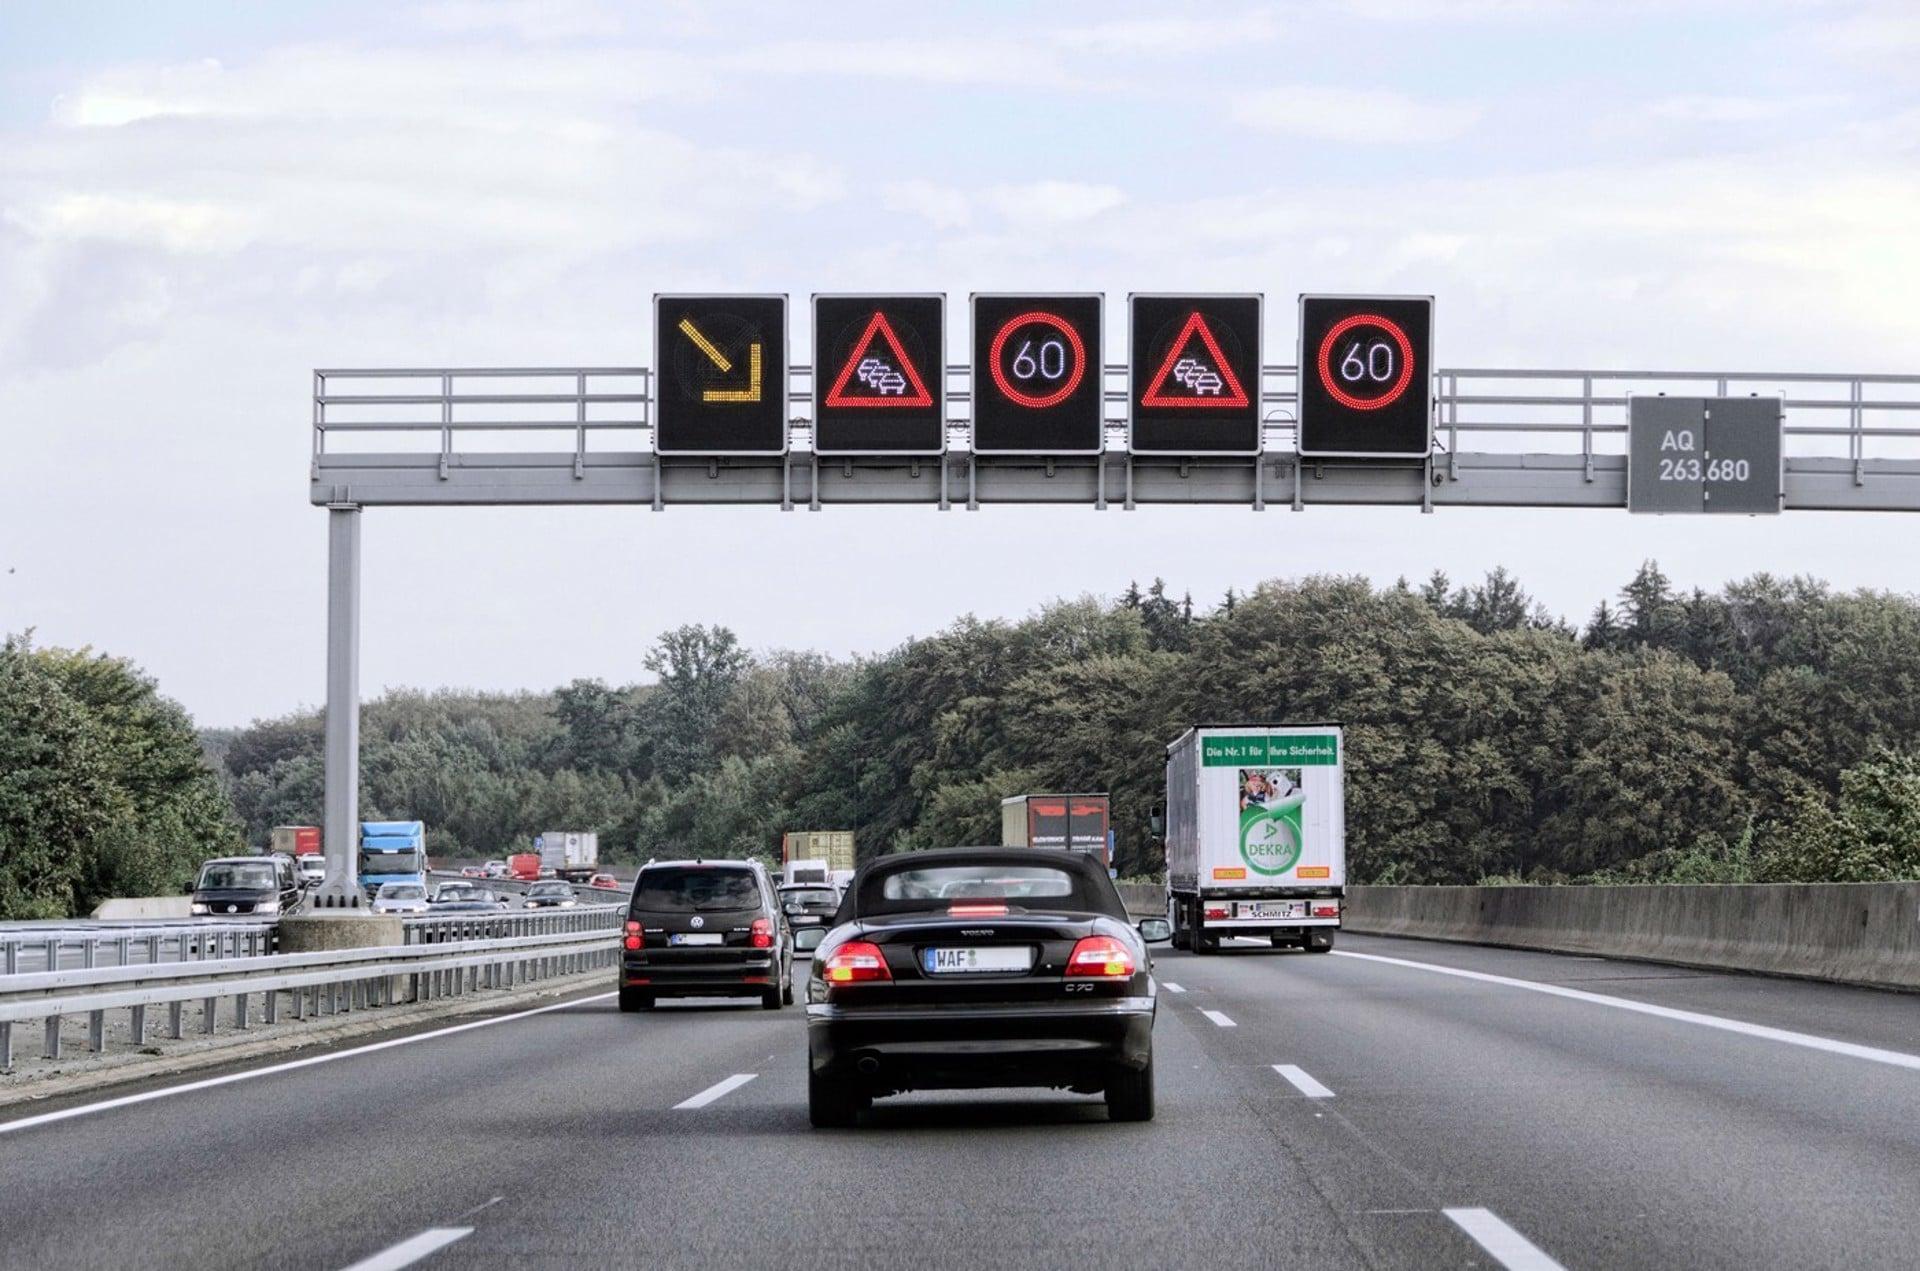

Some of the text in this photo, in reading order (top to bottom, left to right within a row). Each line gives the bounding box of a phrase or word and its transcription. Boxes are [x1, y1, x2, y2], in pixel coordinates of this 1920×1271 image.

[1013, 340, 1064, 379] 60
[1341, 343, 1392, 381] 60
[1660, 430, 1695, 451] AQ
[1206, 747, 1222, 757] Die
[1249, 843, 1292, 856] DEKRA
[937, 950, 966, 967] WAF
